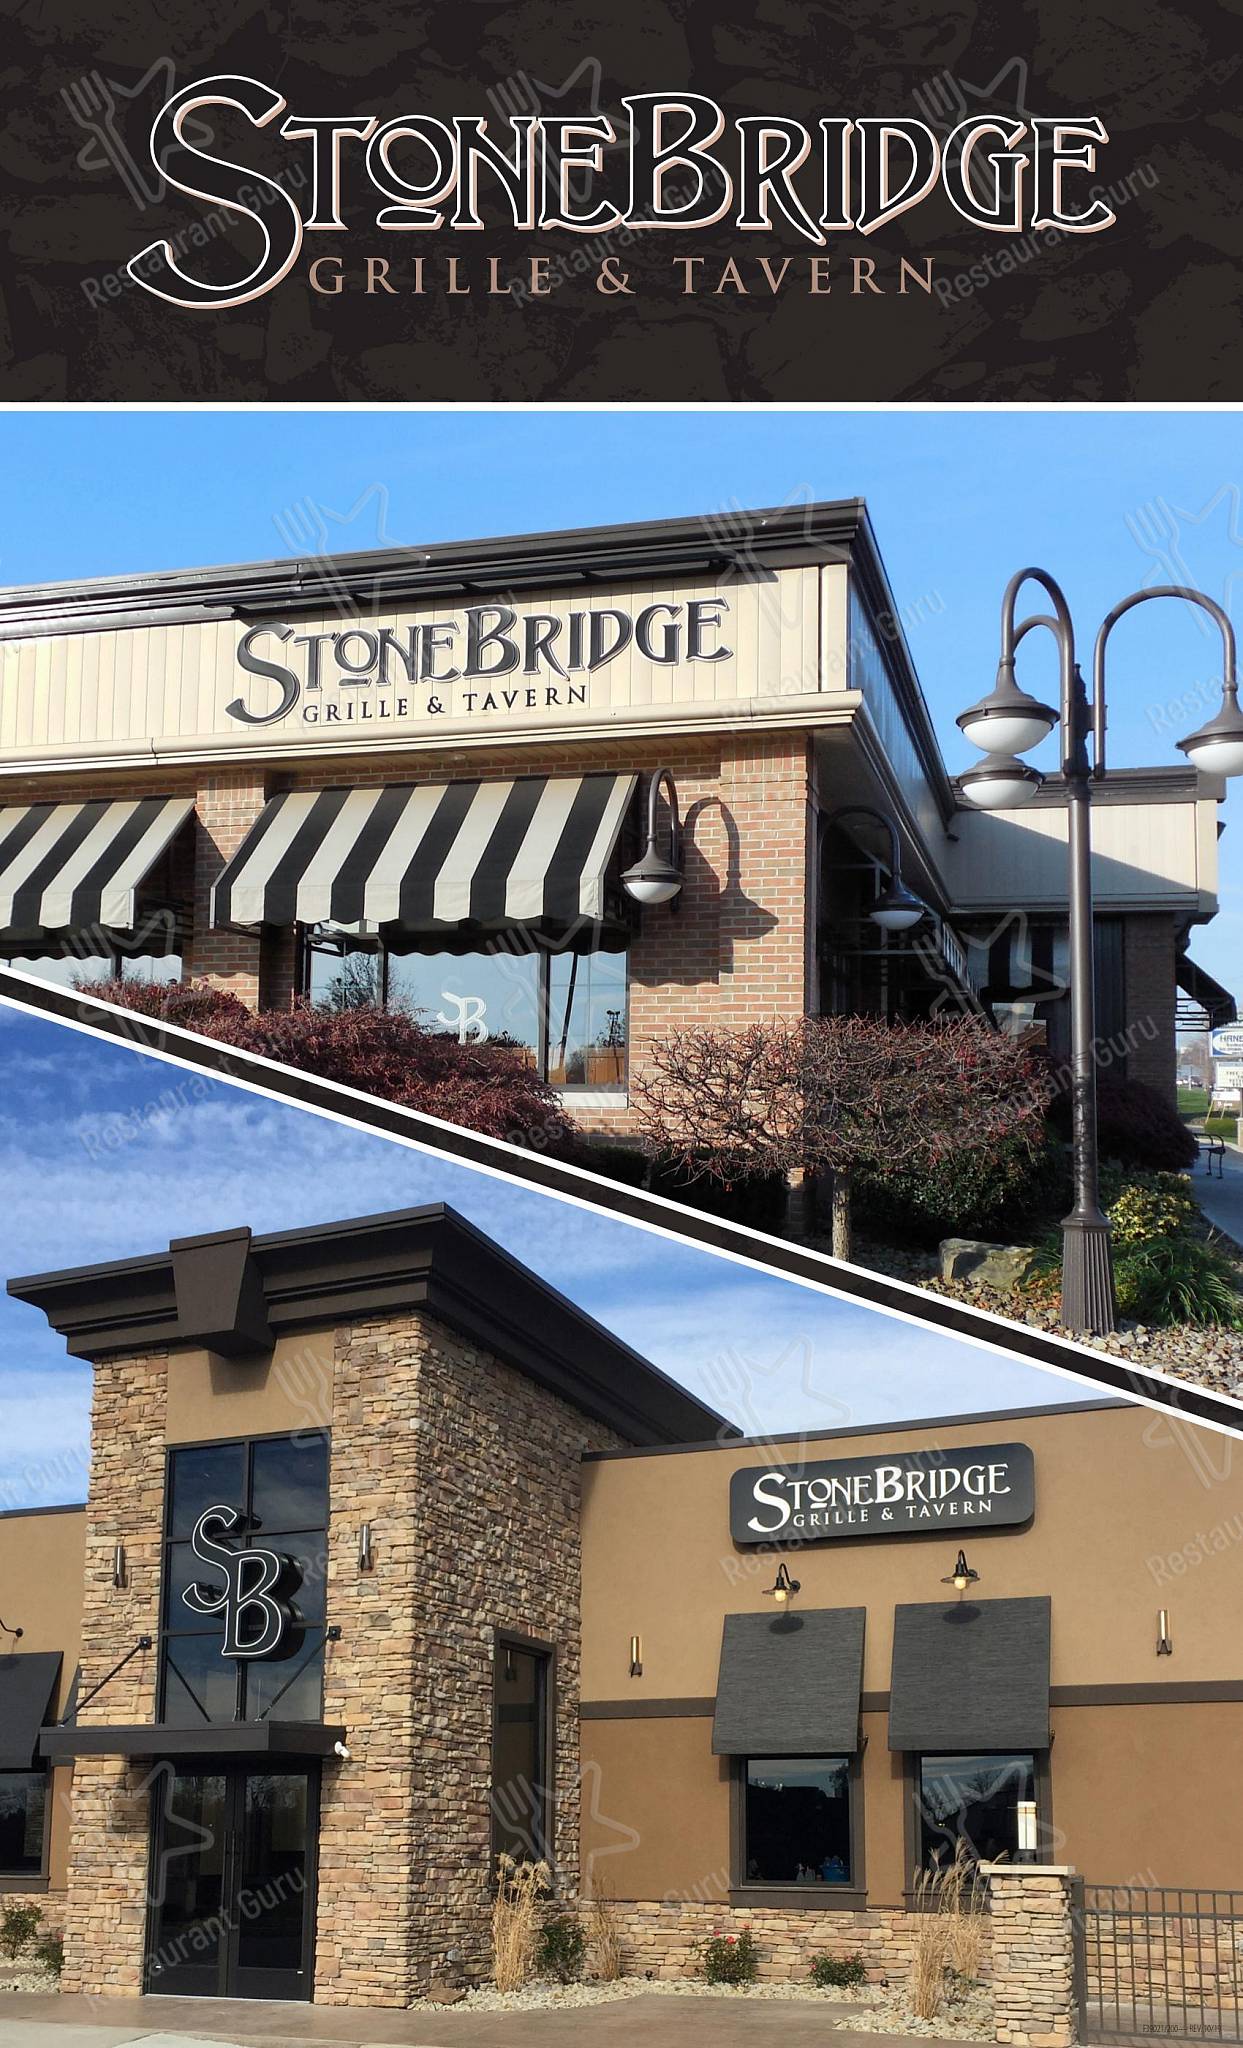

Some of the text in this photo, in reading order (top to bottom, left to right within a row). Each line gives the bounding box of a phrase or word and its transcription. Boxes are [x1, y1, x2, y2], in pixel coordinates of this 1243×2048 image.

[309, 257, 936, 294] GRILLE & TAVERN
[302, 685, 587, 723] GRILLE & TAVERN
[793, 1499, 993, 1528] GRILLE & TAVERN
